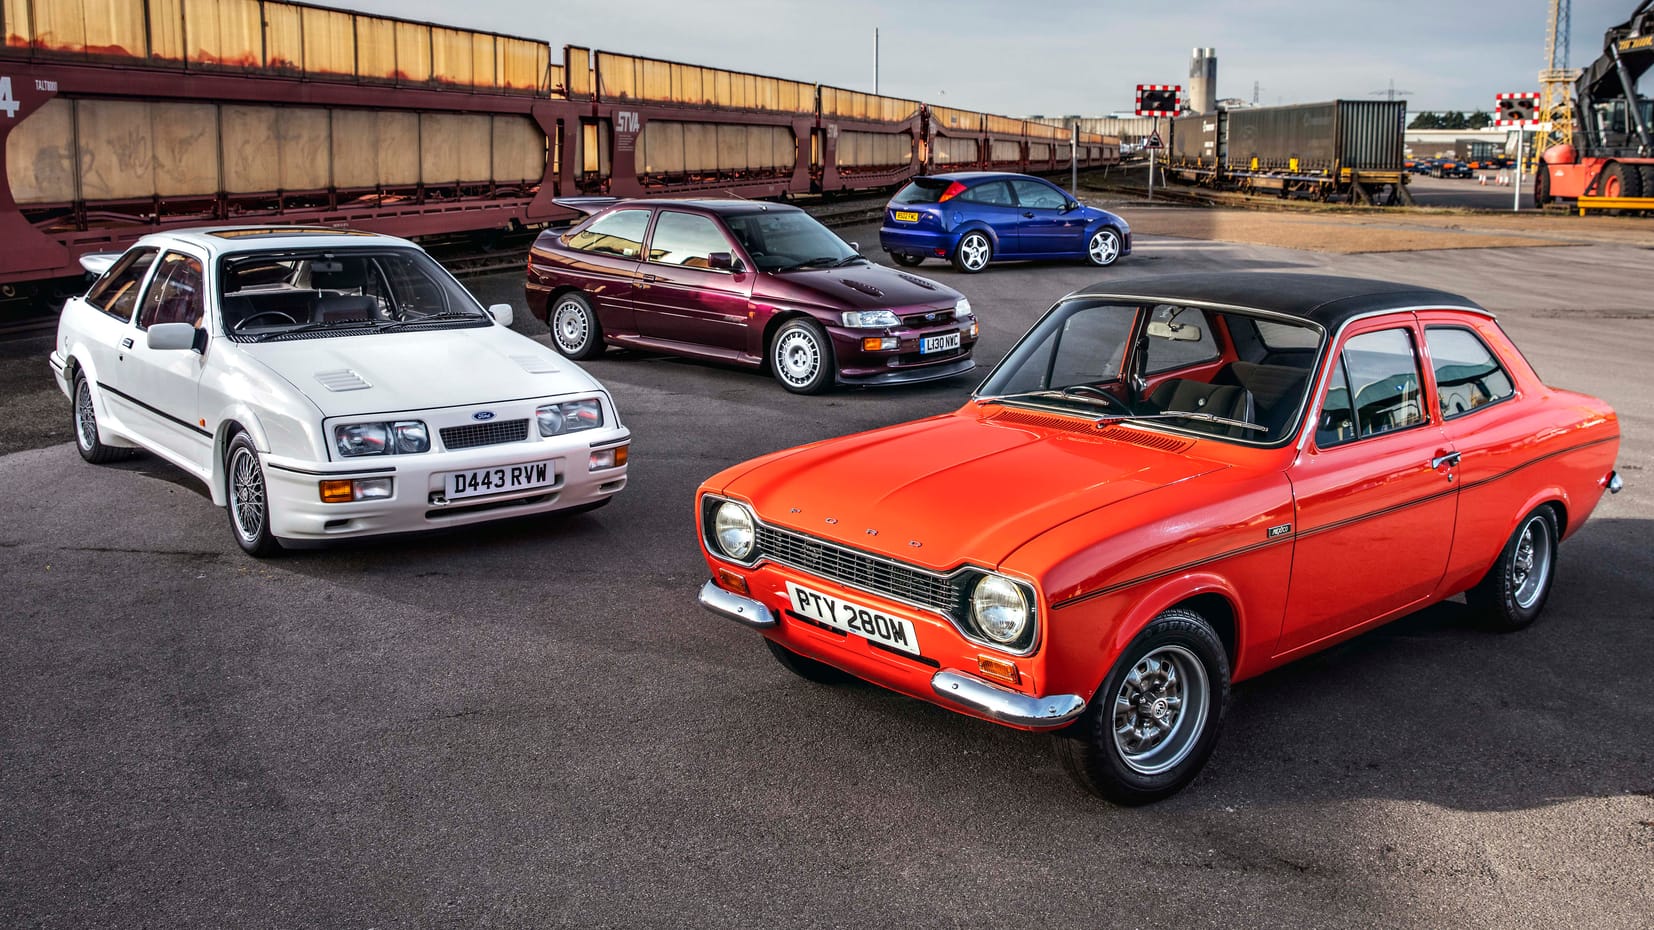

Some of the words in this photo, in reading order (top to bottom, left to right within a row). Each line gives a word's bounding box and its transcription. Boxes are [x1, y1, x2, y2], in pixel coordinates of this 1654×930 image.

[454, 468, 505, 494] D443
[511, 463, 547, 487] RVW
[795, 587, 838, 623] PTY
[843, 604, 909, 647] 280M
